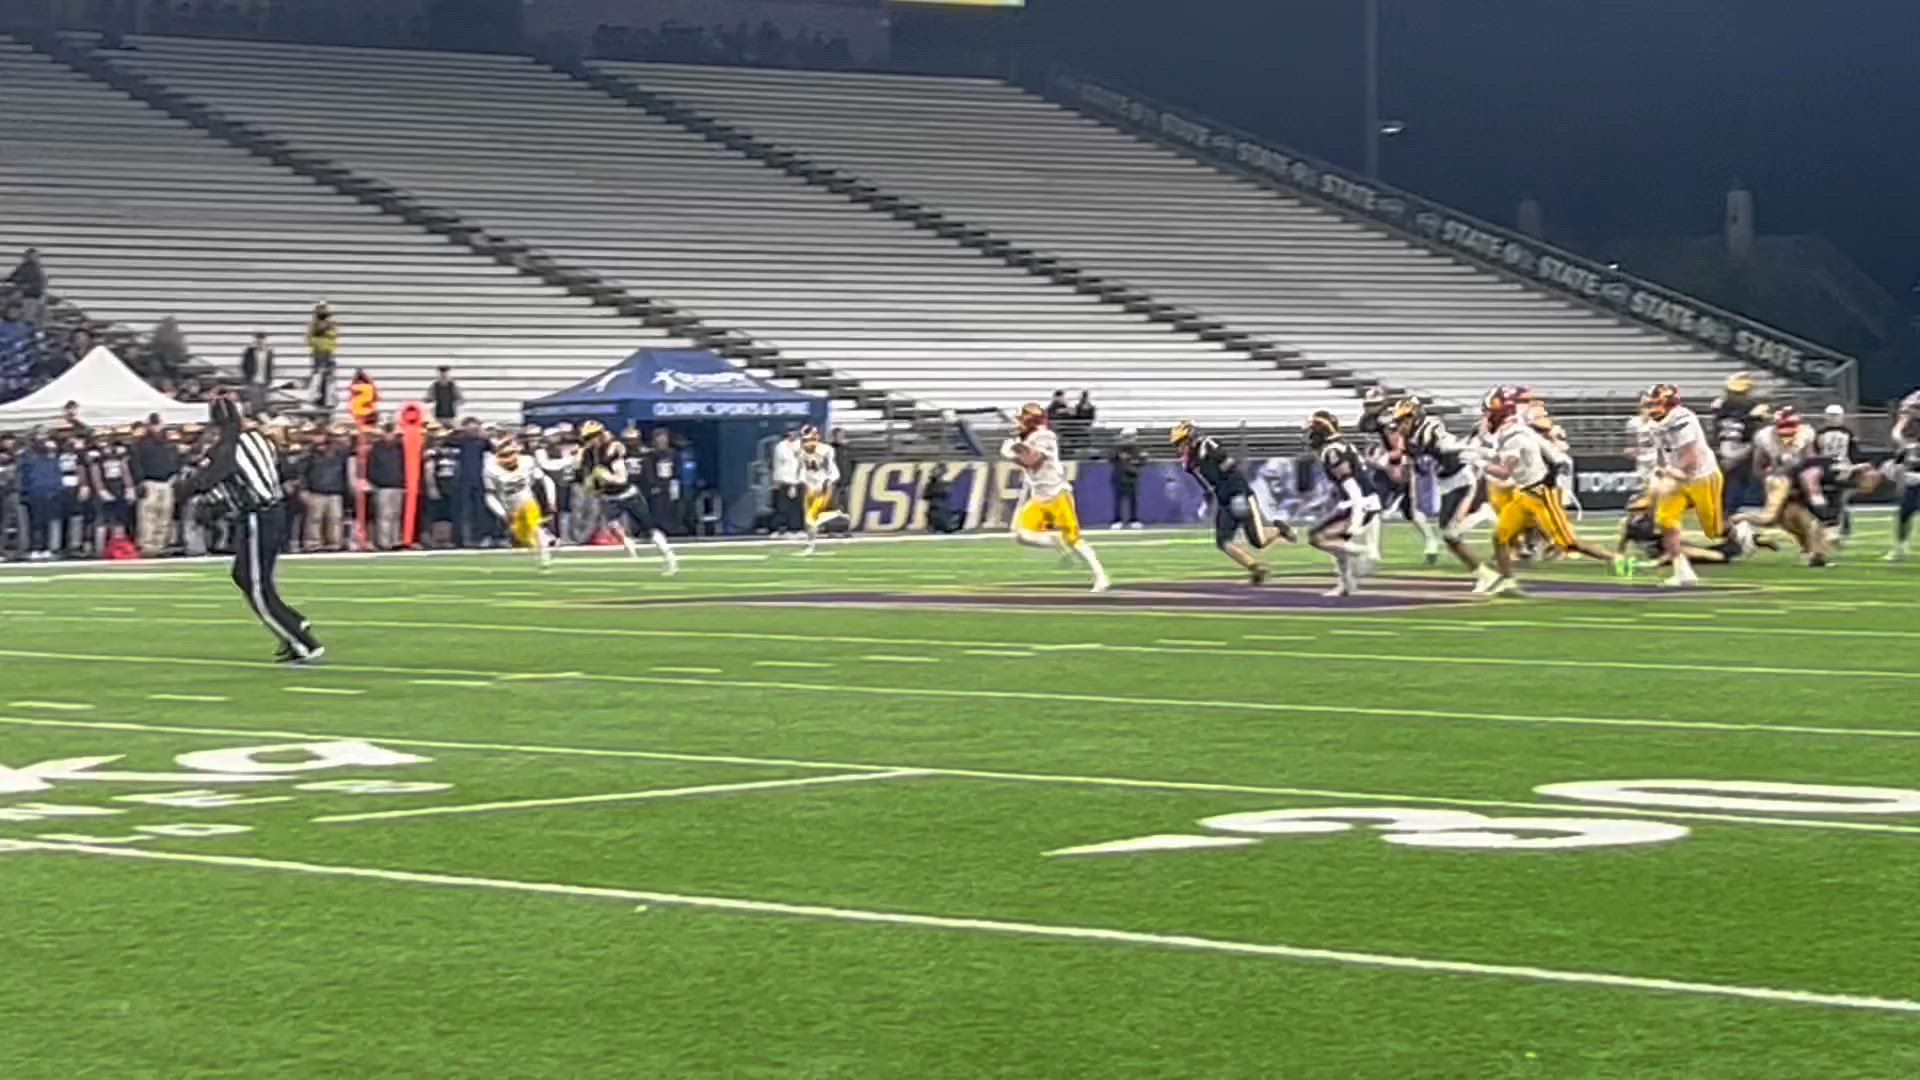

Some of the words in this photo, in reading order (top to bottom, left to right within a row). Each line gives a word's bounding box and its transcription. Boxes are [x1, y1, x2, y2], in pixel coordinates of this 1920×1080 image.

[1323, 174, 1378, 210] STATE
[1443, 221, 1504, 257] STATE
[1539, 257, 1600, 295] STATE
[1630, 292, 1696, 332] STATE
[1736, 331, 1803, 369] STATE
[351, 383, 375, 416] 2
